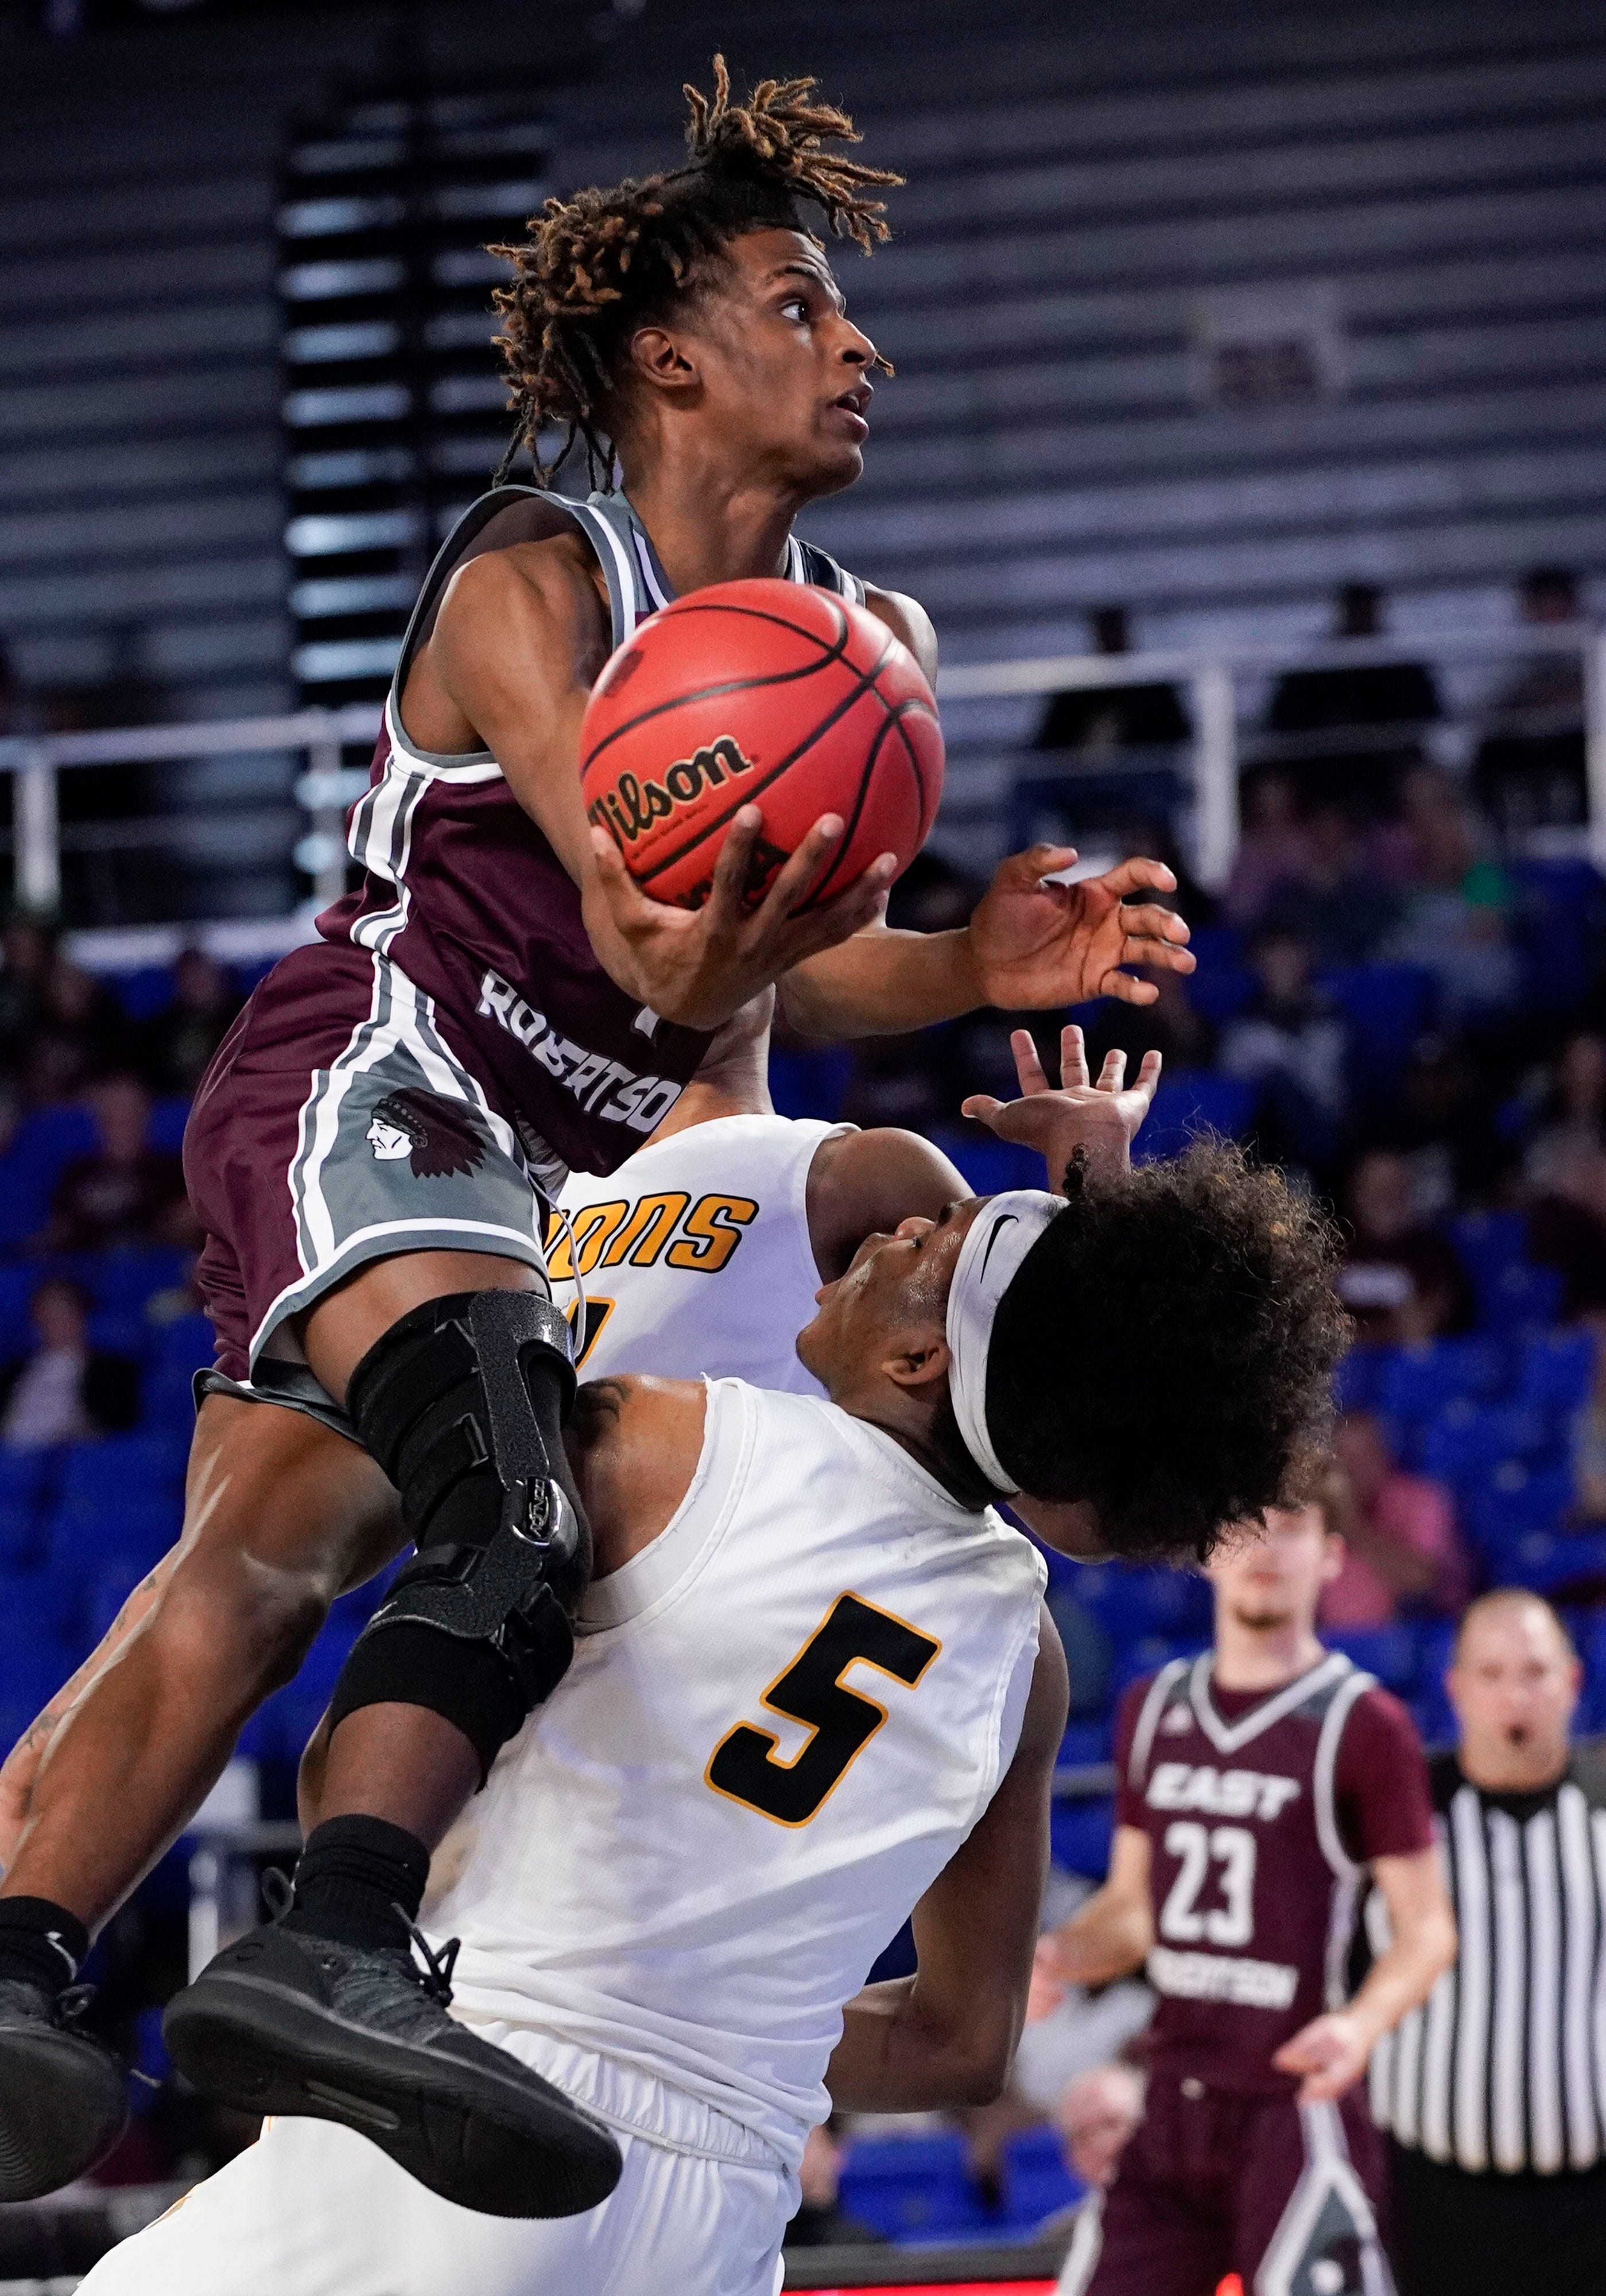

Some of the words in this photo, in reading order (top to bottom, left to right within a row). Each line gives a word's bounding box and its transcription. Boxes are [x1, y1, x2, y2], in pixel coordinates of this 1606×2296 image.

[704, 1589, 942, 1829] 5
[1147, 1763, 1300, 1820] EAST
[1161, 1821, 1256, 1947] 23
